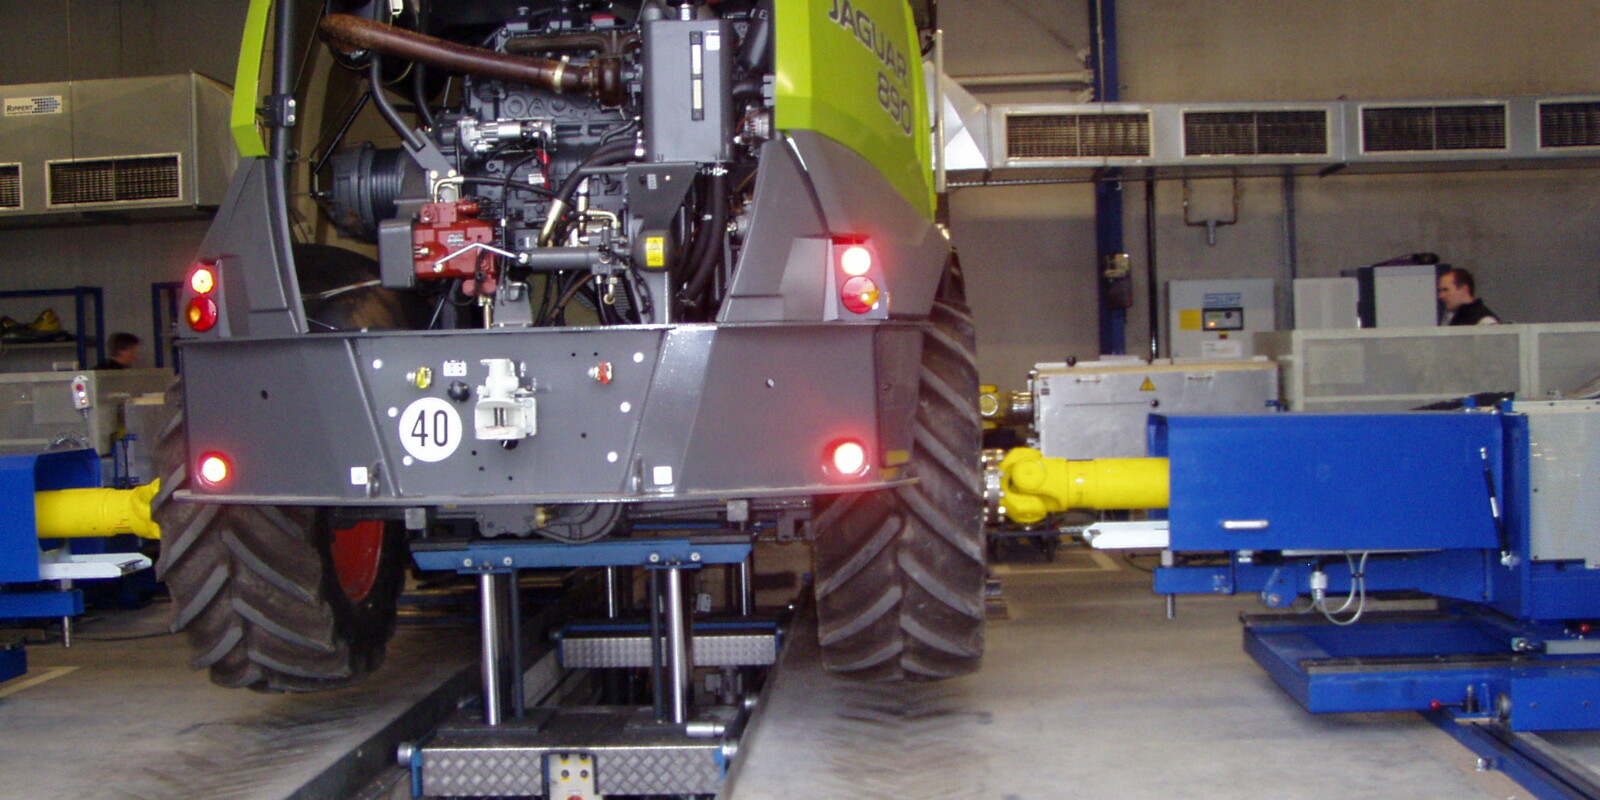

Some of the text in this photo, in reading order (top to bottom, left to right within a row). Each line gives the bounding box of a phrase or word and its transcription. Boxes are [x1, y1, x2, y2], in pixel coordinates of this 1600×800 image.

[828, 0, 909, 90] JAGUAR
[877, 70, 912, 136] 890
[411, 409, 448, 447] 40
